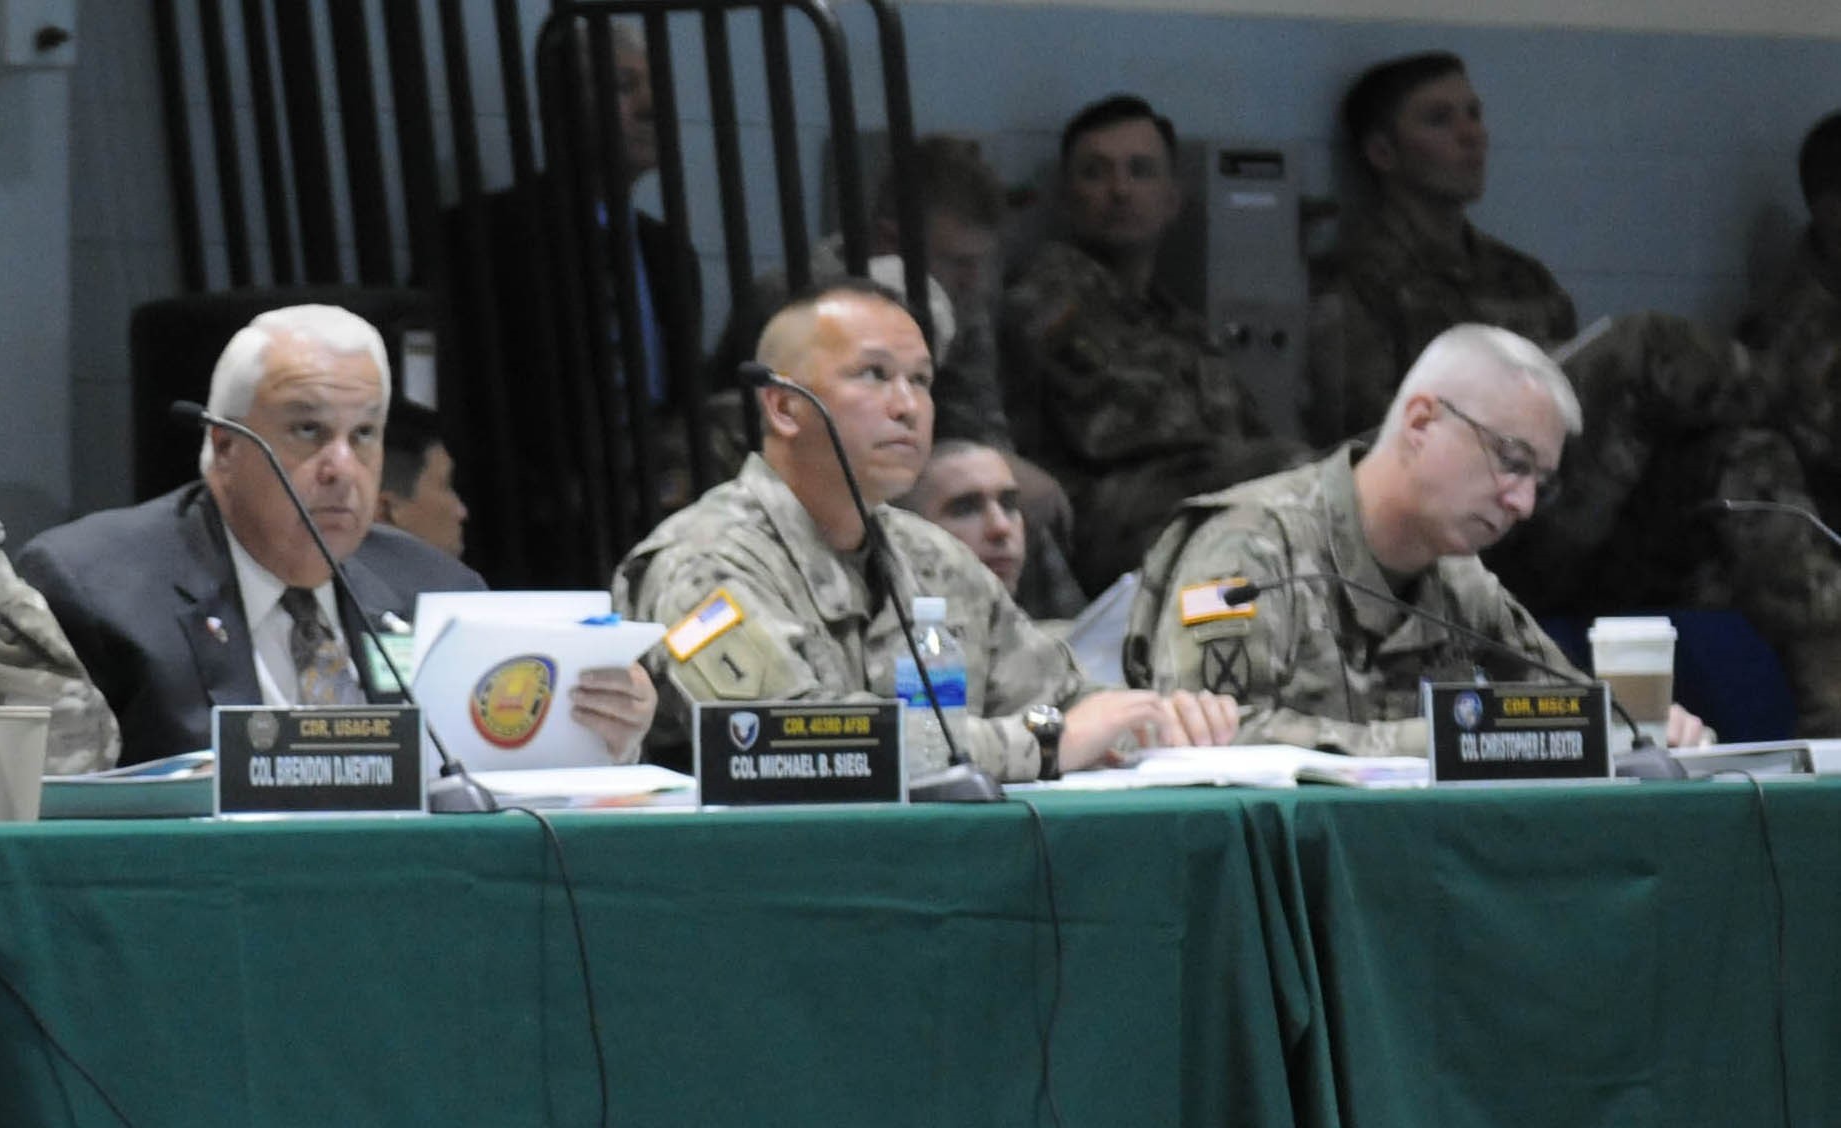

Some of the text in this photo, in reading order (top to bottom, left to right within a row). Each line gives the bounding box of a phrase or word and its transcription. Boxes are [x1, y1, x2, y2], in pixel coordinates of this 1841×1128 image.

[1460, 732, 1480, 762] COL
[249, 755, 274, 787] COL
[275, 754, 332, 786] BRENDON
[730, 754, 758, 780] COL
[759, 753, 817, 779] MICHAEL
[833, 752, 872, 777] SIEGL
